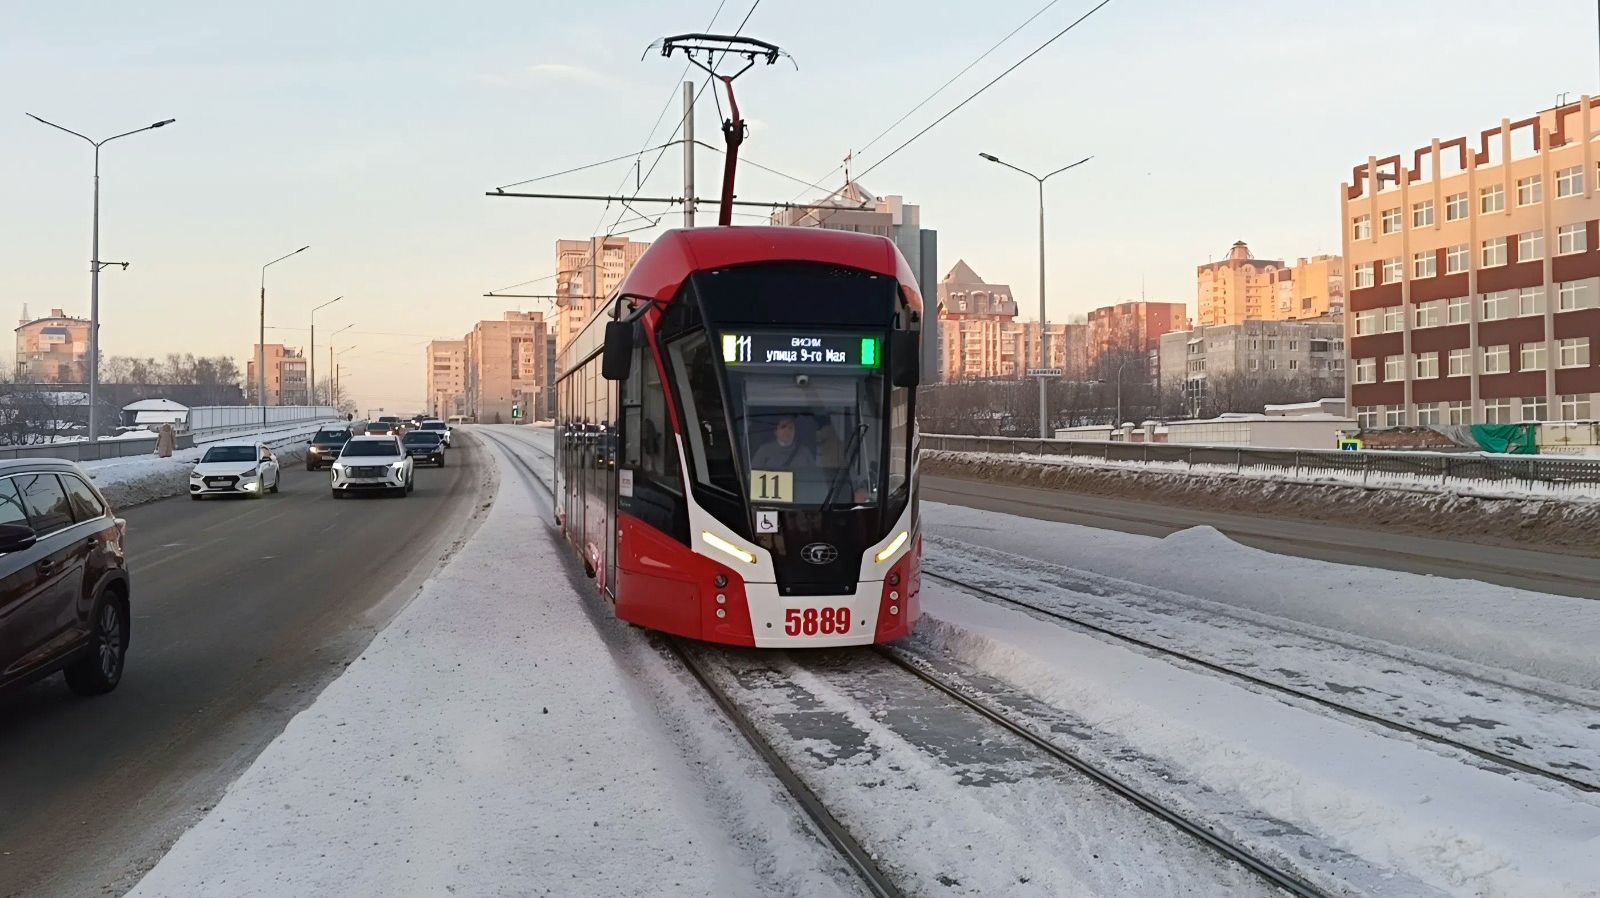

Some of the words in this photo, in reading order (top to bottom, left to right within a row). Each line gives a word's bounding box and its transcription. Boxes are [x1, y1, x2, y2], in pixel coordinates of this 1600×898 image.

[737, 335, 752, 362] 11
[766, 350, 798, 363] улица
[800, 348, 823, 362] 9-го
[825, 349, 846, 363] Мая
[759, 473, 782, 499] 11
[785, 607, 851, 636] 5889
